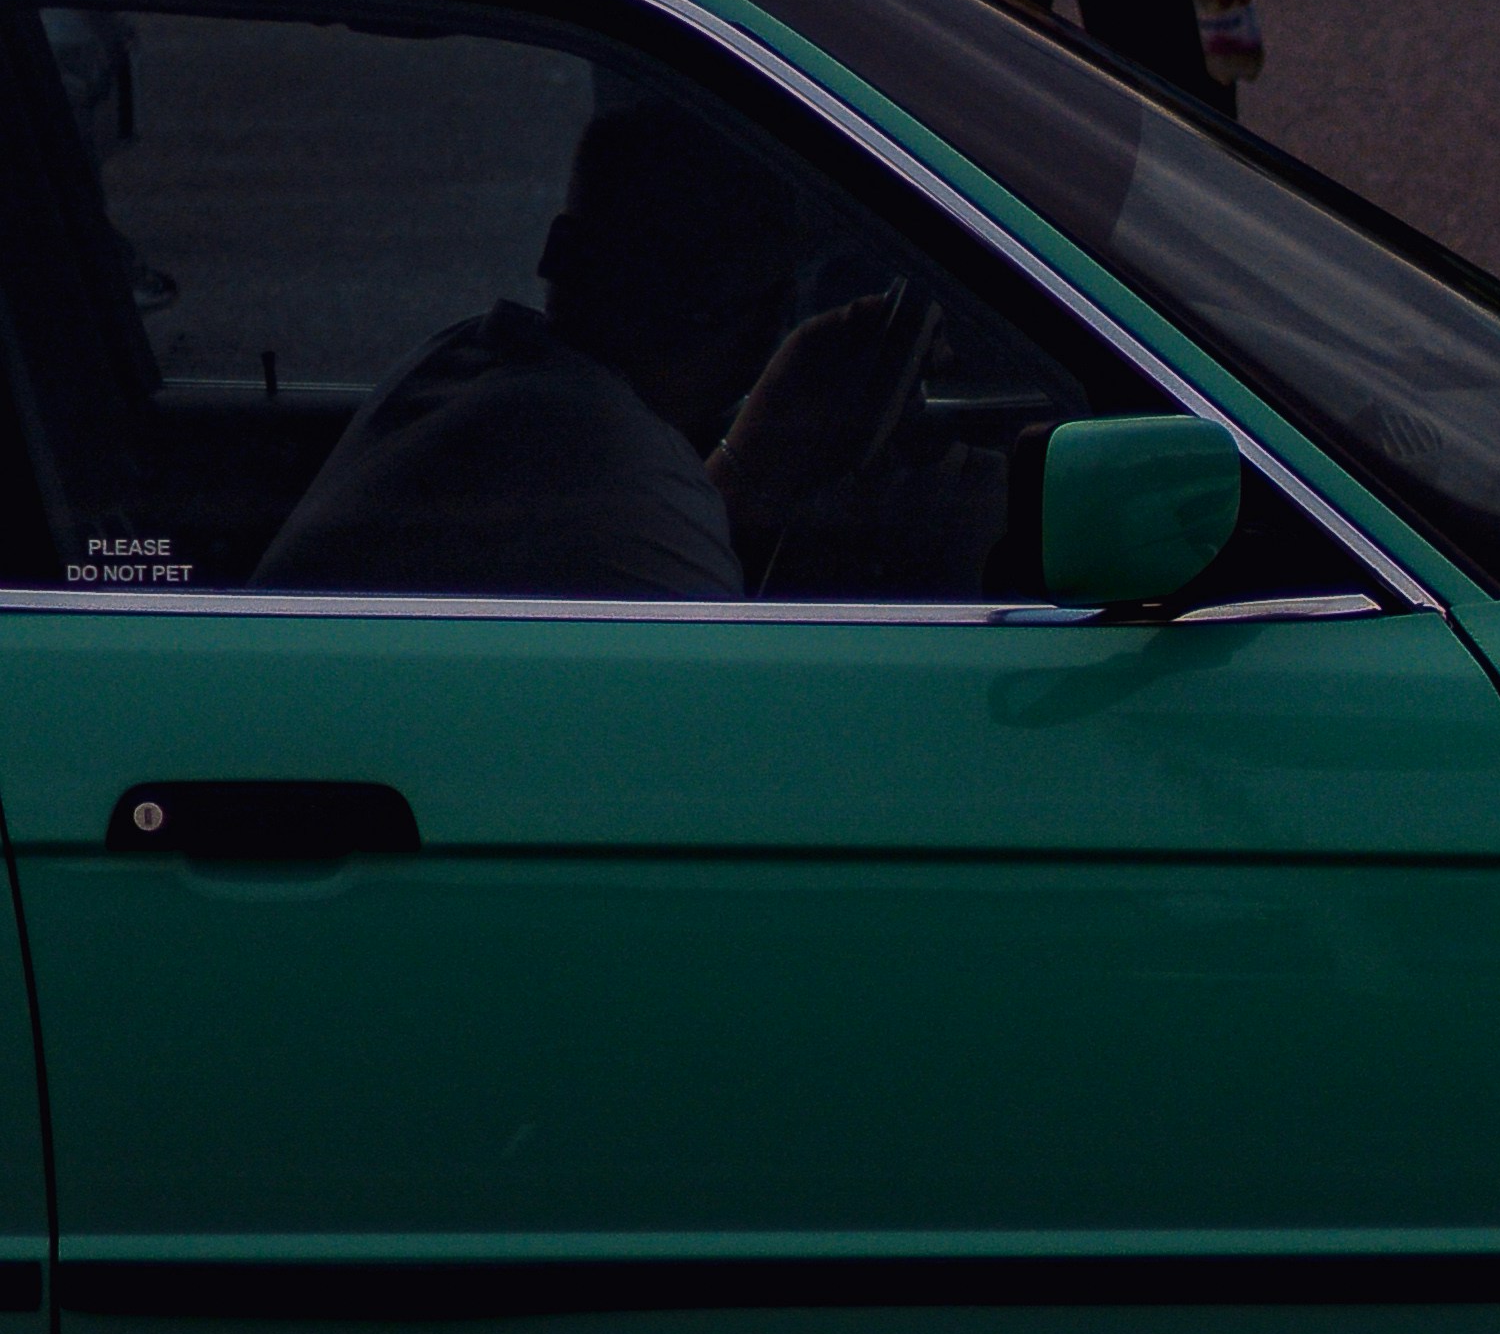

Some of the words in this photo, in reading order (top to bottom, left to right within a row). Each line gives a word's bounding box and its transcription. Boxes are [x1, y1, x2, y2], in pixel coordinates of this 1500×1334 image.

[88, 539, 171, 556] PLEASE
[67, 564, 98, 582] DO
[104, 564, 147, 582] NOT
[152, 564, 193, 582] PET
